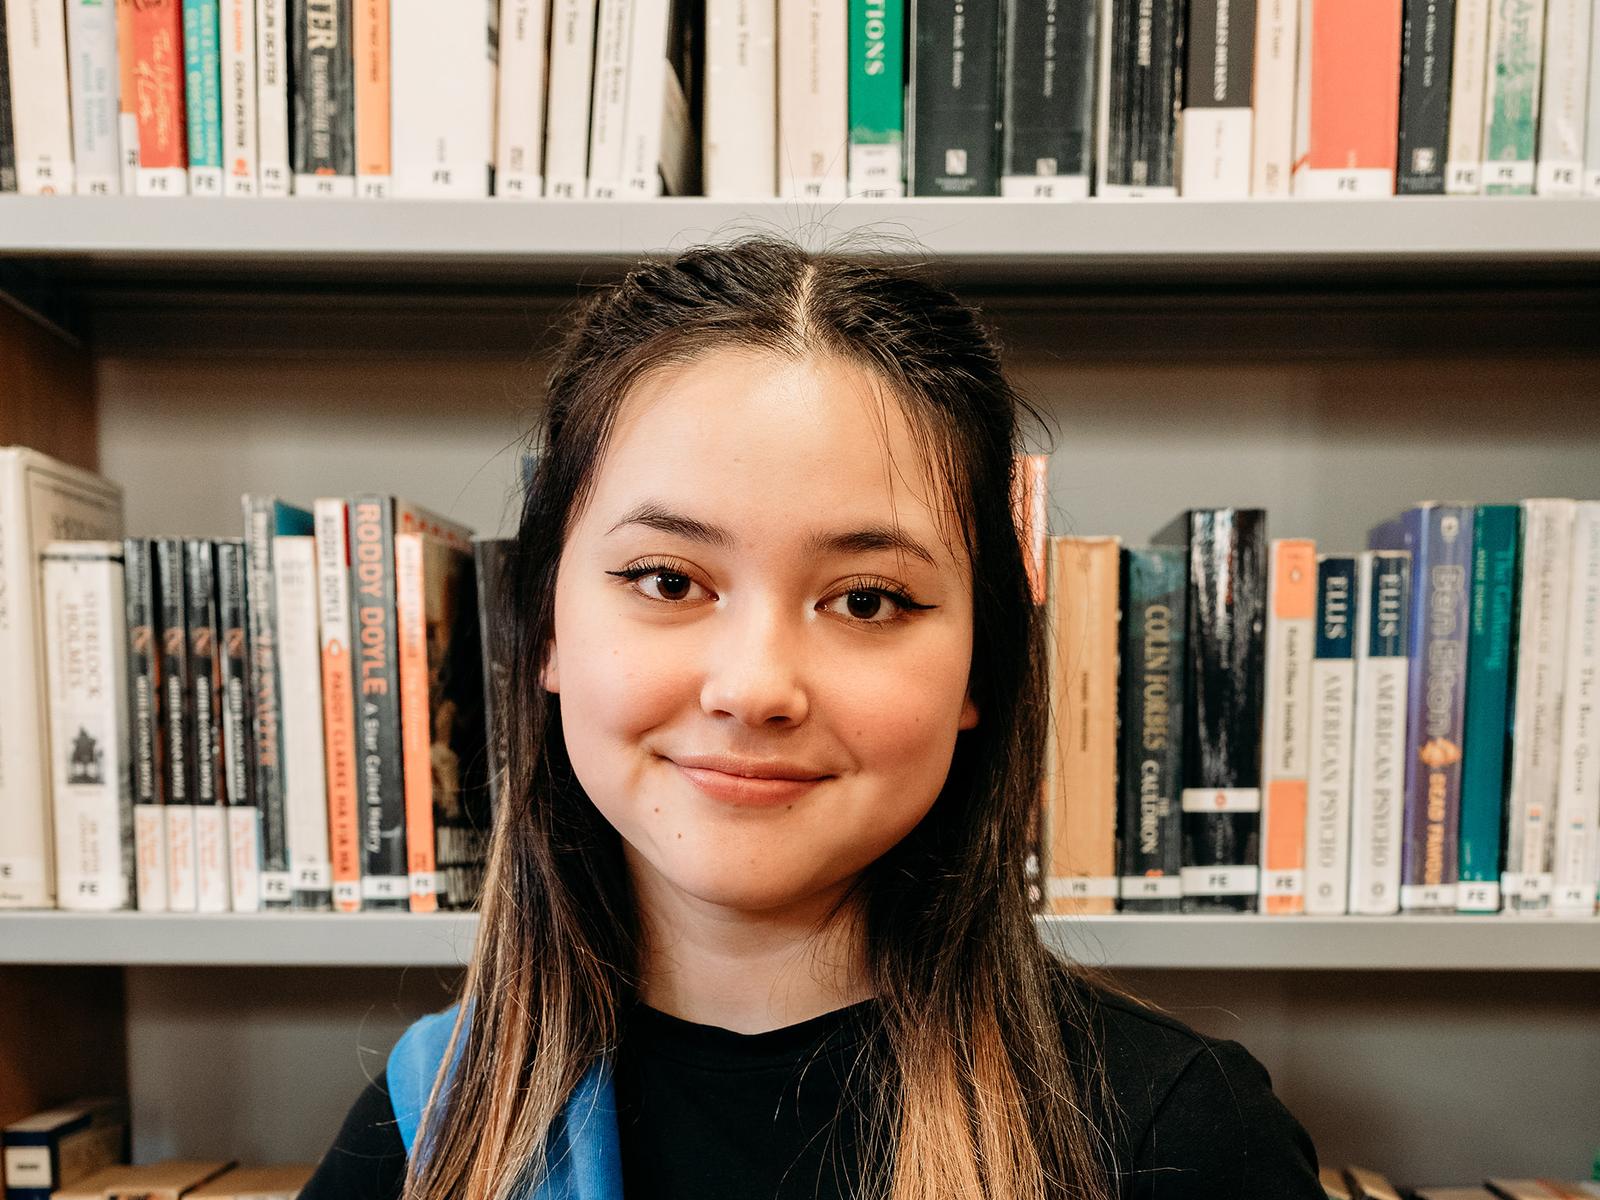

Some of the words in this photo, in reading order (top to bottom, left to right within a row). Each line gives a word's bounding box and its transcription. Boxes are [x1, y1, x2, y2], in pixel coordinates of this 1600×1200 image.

[357, 504, 385, 597] RODDY
[1324, 575, 1348, 639] ELLIS
[1376, 573, 1401, 637] ELLIS
[1430, 565, 1466, 635] Ben
[85, 591, 105, 699] SHERLOCK
[360, 607, 389, 697] DOYLE
[1144, 605, 1171, 670] COLIN
[363, 702, 379, 716] A
[1143, 674, 1170, 751] FORBES
[1424, 639, 1461, 738] Elton
[364, 718, 380, 751] Star
[1321, 671, 1344, 783] AMERICAN
[1374, 670, 1395, 783] AMERICAN
[365, 754, 383, 805] Called
[1139, 759, 1160, 855] CAULDRON
[1427, 773, 1447, 821] DEAD
[365, 806, 383, 855] Henry
[1318, 788, 1342, 868] PSYCHO
[1371, 787, 1393, 867] PSYCHO
[1424, 823, 1446, 886] FAMOU
[79, 881, 98, 894] FE
[1209, 875, 1229, 888] FE
